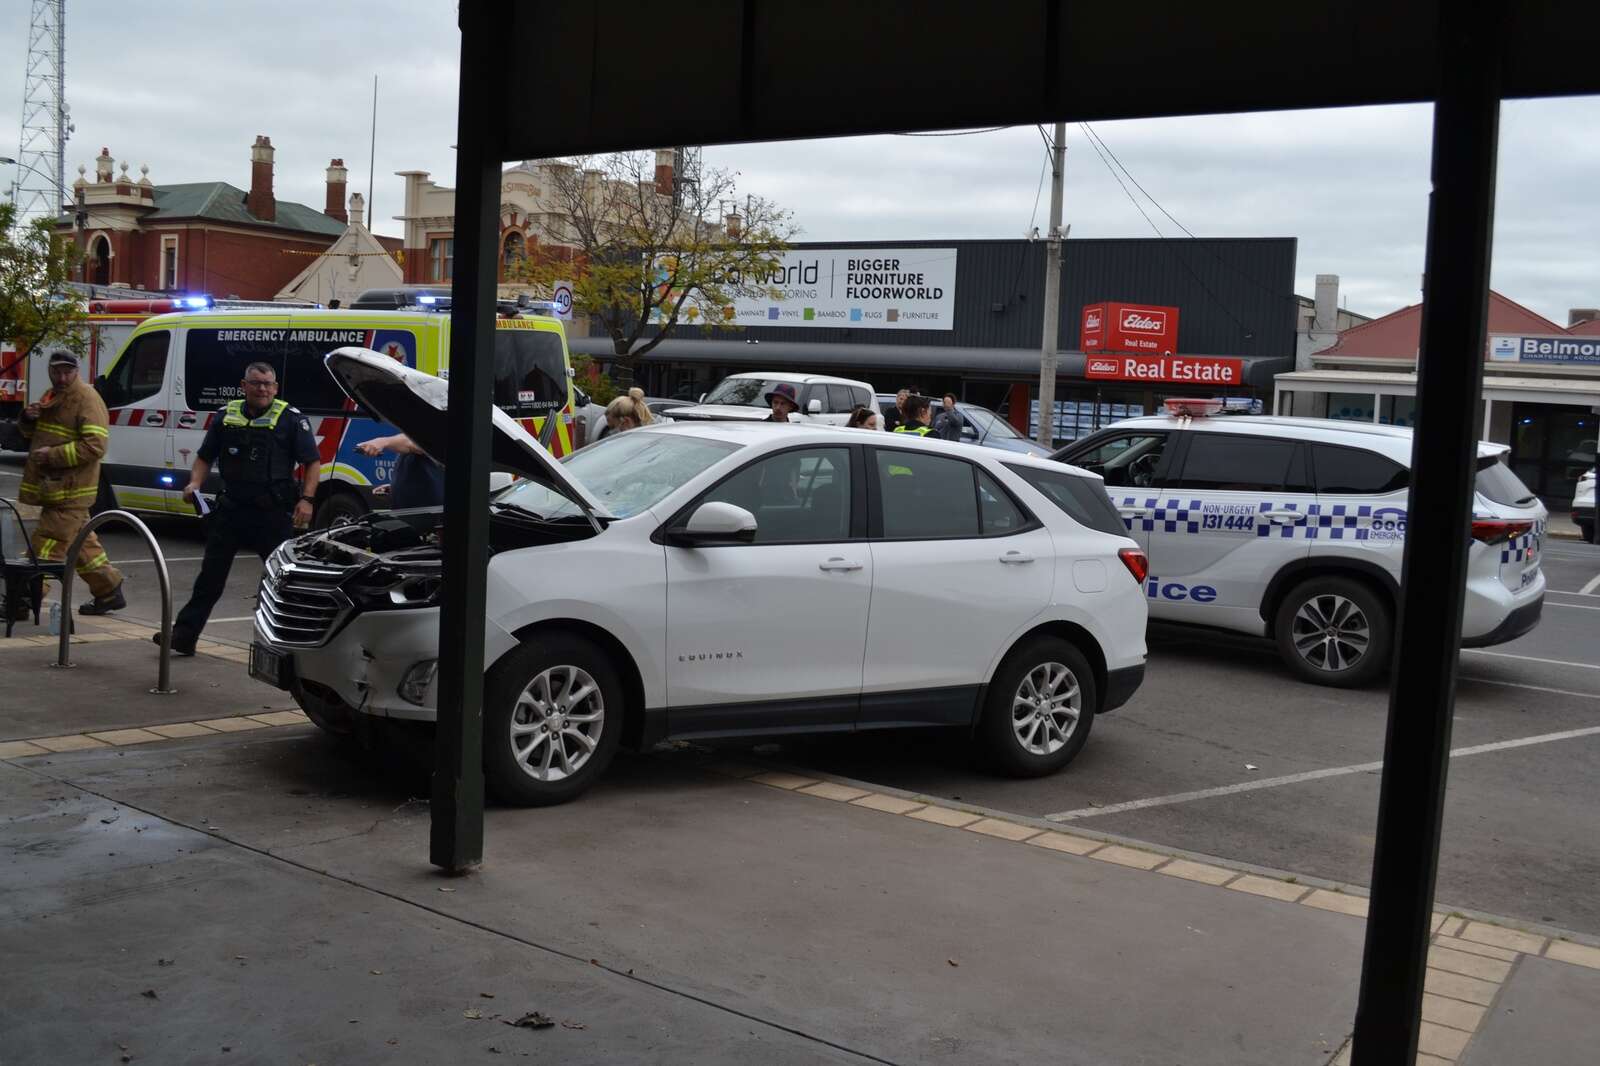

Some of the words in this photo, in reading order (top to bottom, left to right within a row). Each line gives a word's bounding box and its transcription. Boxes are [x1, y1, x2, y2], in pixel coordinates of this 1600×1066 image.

[847, 259, 900, 271] BIGGER
[847, 273, 924, 286] FURNITURE
[846, 287, 943, 300] FLOORWORLD
[557, 294, 570, 307] 40
[864, 311, 882, 319] RUGS
[902, 311, 939, 319] FURNITURE
[1123, 313, 1162, 330] Elders
[217, 330, 286, 342] EMERGENCY
[289, 330, 364, 343] AMBULANCE
[1124, 339, 1138, 347] Real
[1139, 340, 1158, 349] Estate
[1124, 359, 1165, 379] Real
[1171, 360, 1233, 381] Estate
[1202, 504, 1256, 515] NON-URGENT
[1202, 514, 1222, 529] 131
[1224, 515, 1254, 530] 444
[1147, 576, 1217, 602] ice
[678, 651, 743, 662] EQUINOX
